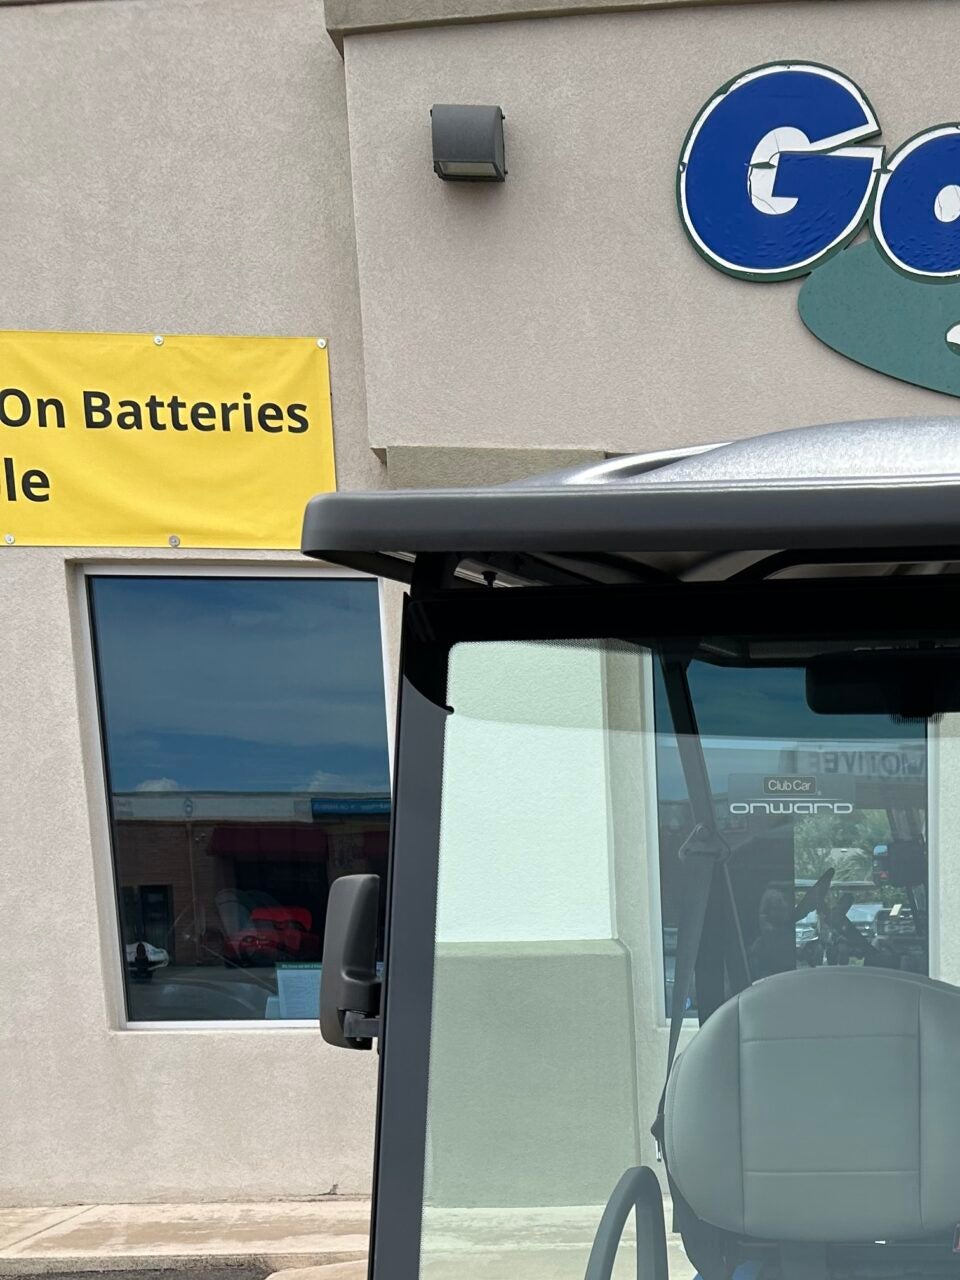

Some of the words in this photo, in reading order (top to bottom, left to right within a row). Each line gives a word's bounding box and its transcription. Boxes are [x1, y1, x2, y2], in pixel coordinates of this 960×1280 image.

[0, 387, 66, 428] On
[82, 390, 310, 434] Batteries
[0, 457, 51, 503] le
[767, 780, 792, 792] Club
[792, 780, 812, 791] Car
